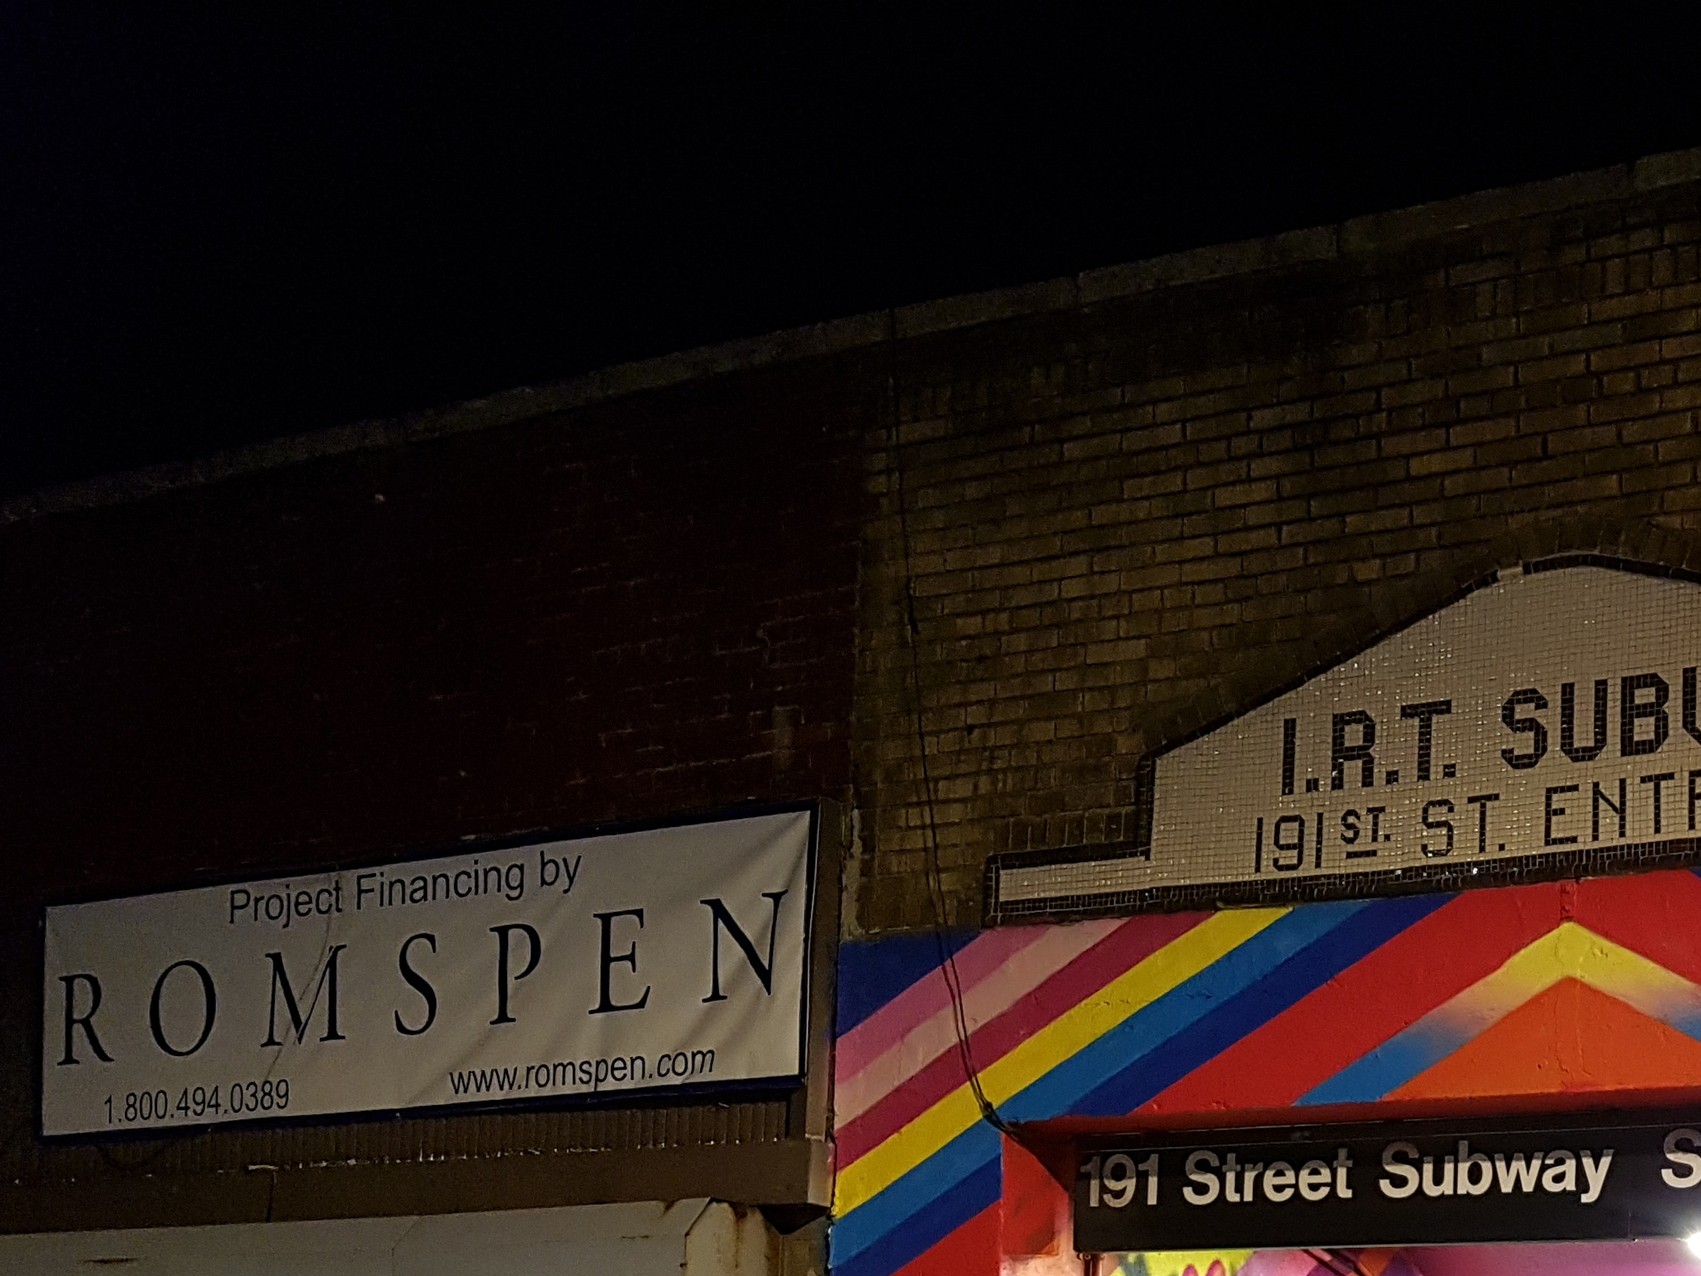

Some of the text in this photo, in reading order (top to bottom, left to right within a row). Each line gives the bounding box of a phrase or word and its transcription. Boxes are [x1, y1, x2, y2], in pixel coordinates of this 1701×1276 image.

[1282, 699, 1457, 796] I.R.T.
[1421, 796, 1507, 858] ST.
[228, 850, 583, 928] Project Financing by
[57, 890, 789, 1067] ROMSPEN
[104, 1046, 716, 1124] 1.800.494.0389 www.romspen.com
[1079, 1153, 1160, 1208] 191
[1182, 1147, 1354, 1207] Street
[1378, 1140, 1614, 1204] Subway
